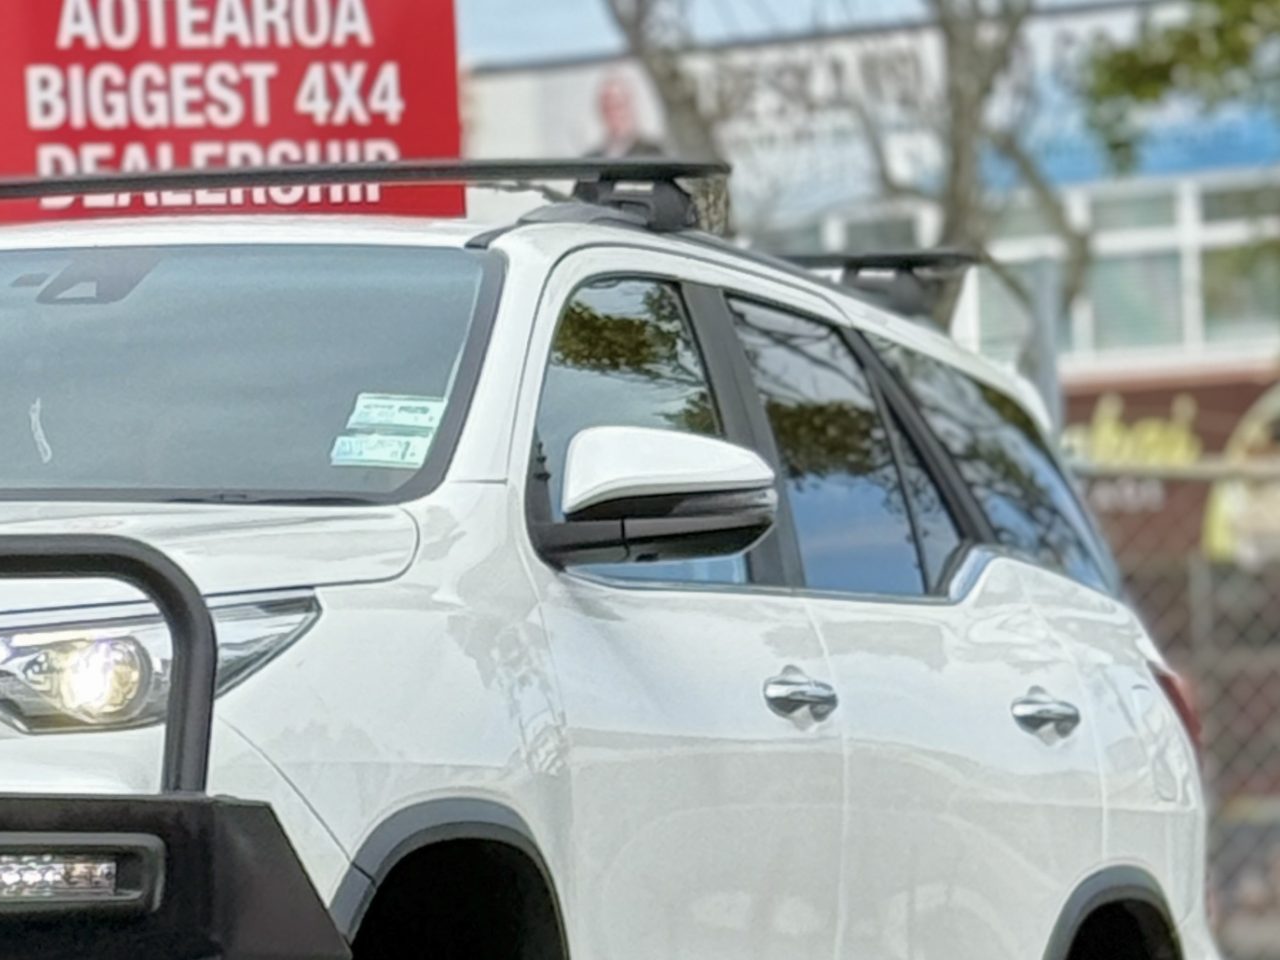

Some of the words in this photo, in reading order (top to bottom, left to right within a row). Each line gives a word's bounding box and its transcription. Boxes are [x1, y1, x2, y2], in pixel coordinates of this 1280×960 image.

[56, 0, 373, 48] AOTEAROA
[25, 63, 277, 130] BIGGEST
[295, 61, 405, 126] 4X4
[36, 139, 400, 209] DEALERSHIP
